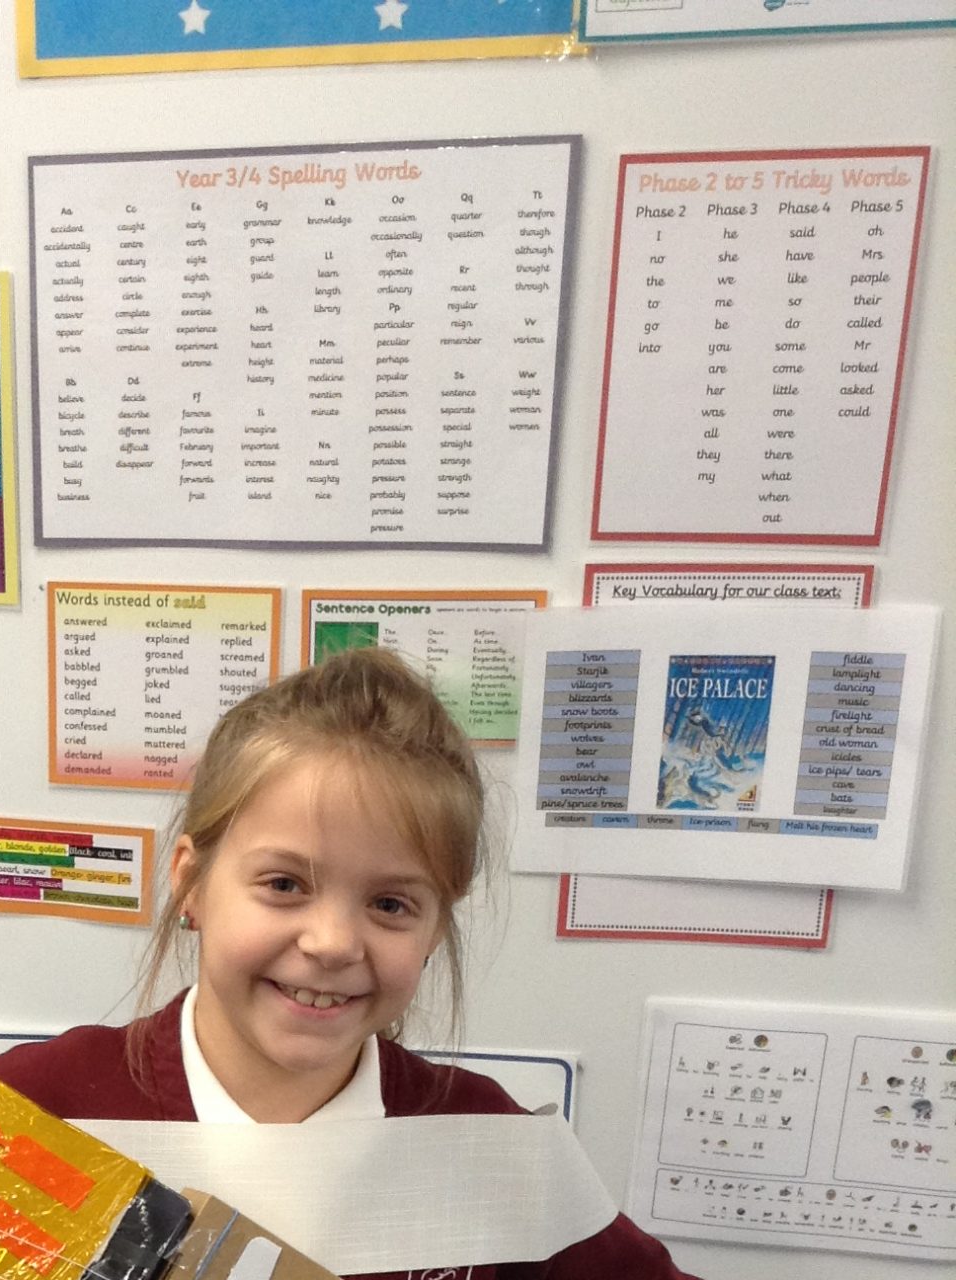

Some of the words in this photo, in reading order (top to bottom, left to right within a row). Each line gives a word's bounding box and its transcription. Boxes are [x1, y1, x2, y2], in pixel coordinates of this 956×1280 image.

[177, 169, 221, 188] Year
[226, 166, 262, 188] 3/4
[268, 162, 347, 190] Spelling
[355, 160, 422, 182] Words
[639, 173, 700, 193] Phase
[705, 173, 717, 190] 2
[725, 173, 745, 189] to
[752, 171, 764, 189] 5
[773, 171, 832, 195] Tricky
[842, 168, 910, 188] Words
[636, 207, 675, 218] Phase
[678, 205, 686, 217] 2
[708, 204, 746, 216] Phase
[750, 203, 757, 215] 3
[779, 202, 819, 214] Phase
[822, 202, 830, 213] 4
[851, 200, 891, 213] Phase
[896, 200, 903, 212] 5
[243, 218, 282, 229] grammar
[789, 227, 815, 238] said
[385, 251, 407, 260] often
[785, 250, 814, 261] have
[862, 249, 883, 260] Mrs
[646, 276, 665, 287] the
[850, 272, 890, 285] people
[847, 318, 883, 329] called
[708, 343, 731, 354] you
[840, 363, 879, 374] looked
[773, 385, 798, 395] little
[697, 450, 720, 463] they
[612, 585, 636, 598] Key
[642, 585, 718, 599] Vocabulary
[722, 585, 743, 599] for
[747, 588, 770, 598] our
[774, 585, 808, 597] class
[56, 592, 98, 606] Words
[104, 595, 150, 608] instead
[156, 595, 169, 608] of
[316, 604, 374, 614] Sentence
[379, 604, 431, 616] Openers
[64, 617, 107, 626] answered
[146, 620, 191, 629] exclaimed
[221, 622, 266, 631] remarked
[843, 654, 873, 666] fiddle
[220, 669, 257, 677] shouted
[64, 677, 97, 688] begged
[144, 680, 169, 691] joked
[670, 678, 698, 698] ICE
[702, 678, 768, 698] PALACE
[834, 682, 875, 695] dancing
[145, 711, 181, 719] moaned
[830, 710, 872, 723] firelight
